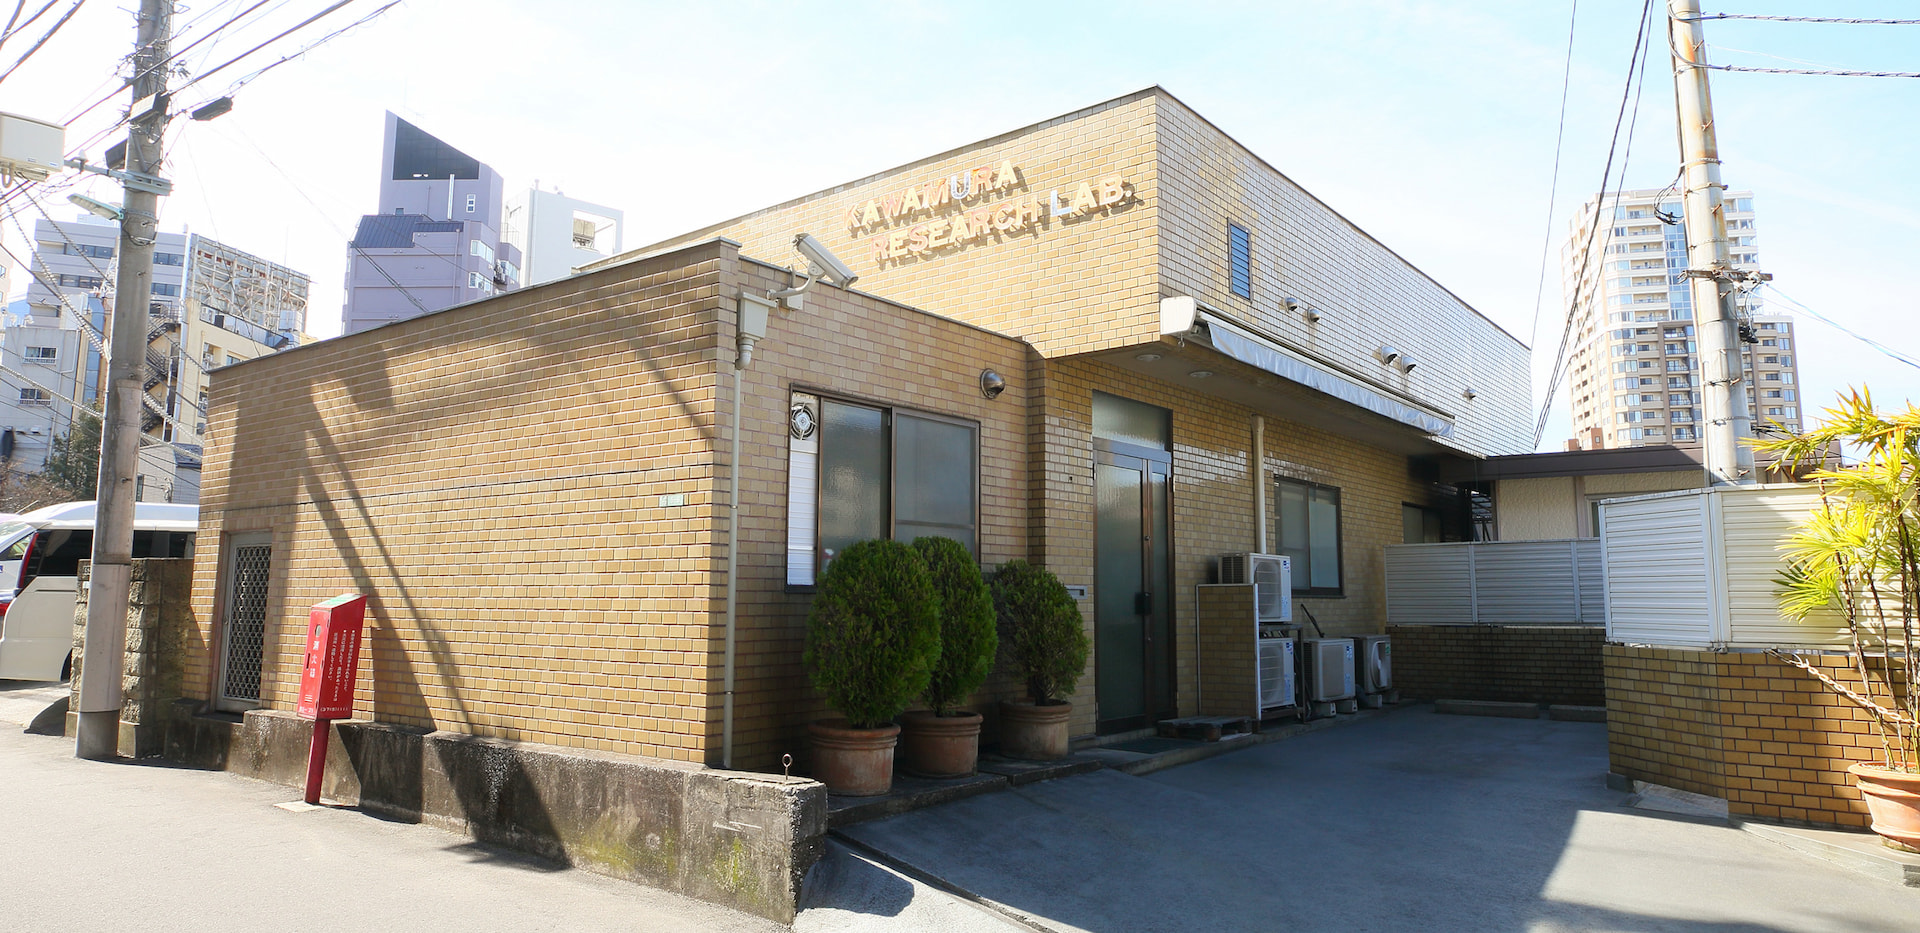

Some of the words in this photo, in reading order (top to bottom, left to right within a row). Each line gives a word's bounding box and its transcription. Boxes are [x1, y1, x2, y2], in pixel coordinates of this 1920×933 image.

[843, 159, 1019, 230] KAWAMURA
[869, 195, 1039, 262] RESEARCH
[1050, 173, 1133, 218] LAB.
